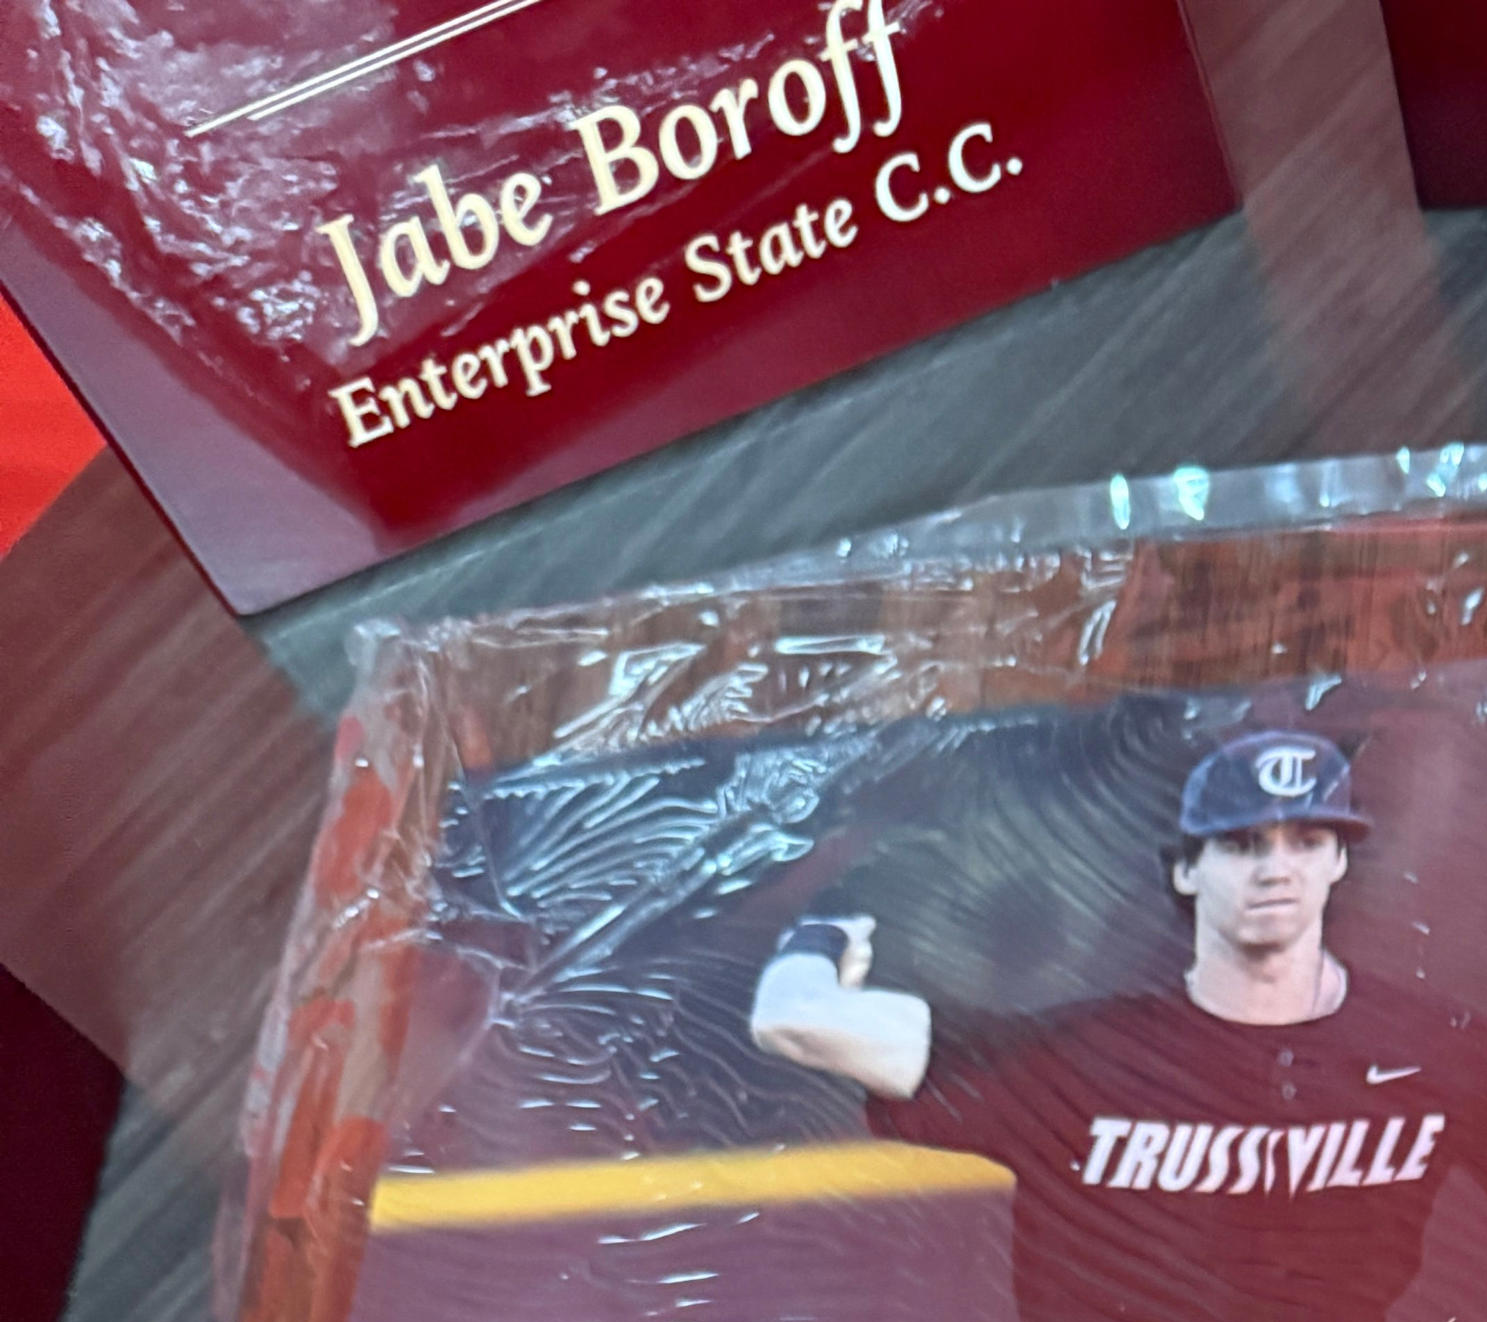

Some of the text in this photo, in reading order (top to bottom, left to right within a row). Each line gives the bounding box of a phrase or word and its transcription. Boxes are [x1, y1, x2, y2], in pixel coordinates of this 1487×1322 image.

[315, 0, 902, 347] Jabe Boroff
[328, 122, 1023, 448] Enterprise State C.C.
[1081, 1113, 1446, 1199] TRUSSVILLE
